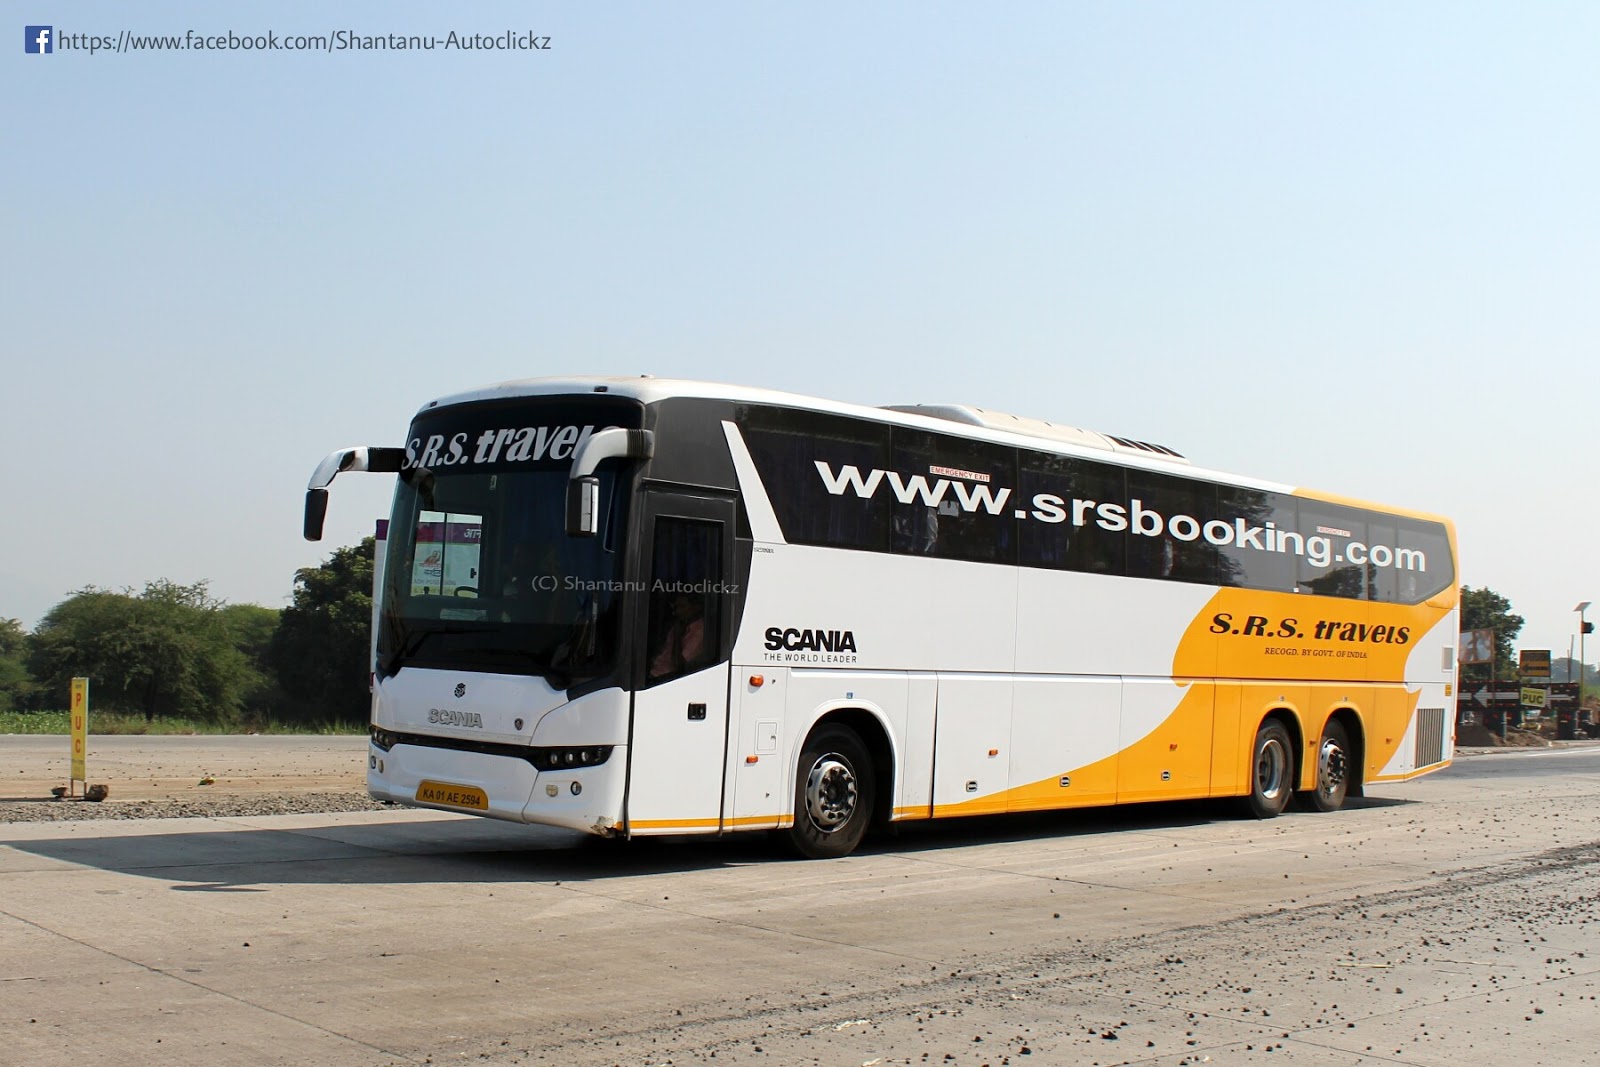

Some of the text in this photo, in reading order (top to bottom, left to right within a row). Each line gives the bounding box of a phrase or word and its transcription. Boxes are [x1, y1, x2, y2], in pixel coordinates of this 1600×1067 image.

[401, 425, 619, 470] S.R.S. travel
[930, 467, 989, 481] EMERGENCY EXIT
[813, 460, 1427, 573] www.srsbooking.com
[1209, 613, 1410, 645] S.R.S. travels
[764, 627, 857, 653] SCANIA
[764, 653, 857, 663] THE WORLD LEADER
[1265, 647, 1299, 656] RECOGD.
[1312, 649, 1335, 657] GOVT.
[1336, 650, 1346, 658] OF
[1522, 693, 1543, 704] PUC
[428, 708, 483, 728] SCANIA
[423, 788, 481, 805] KA 01 AE 2594
